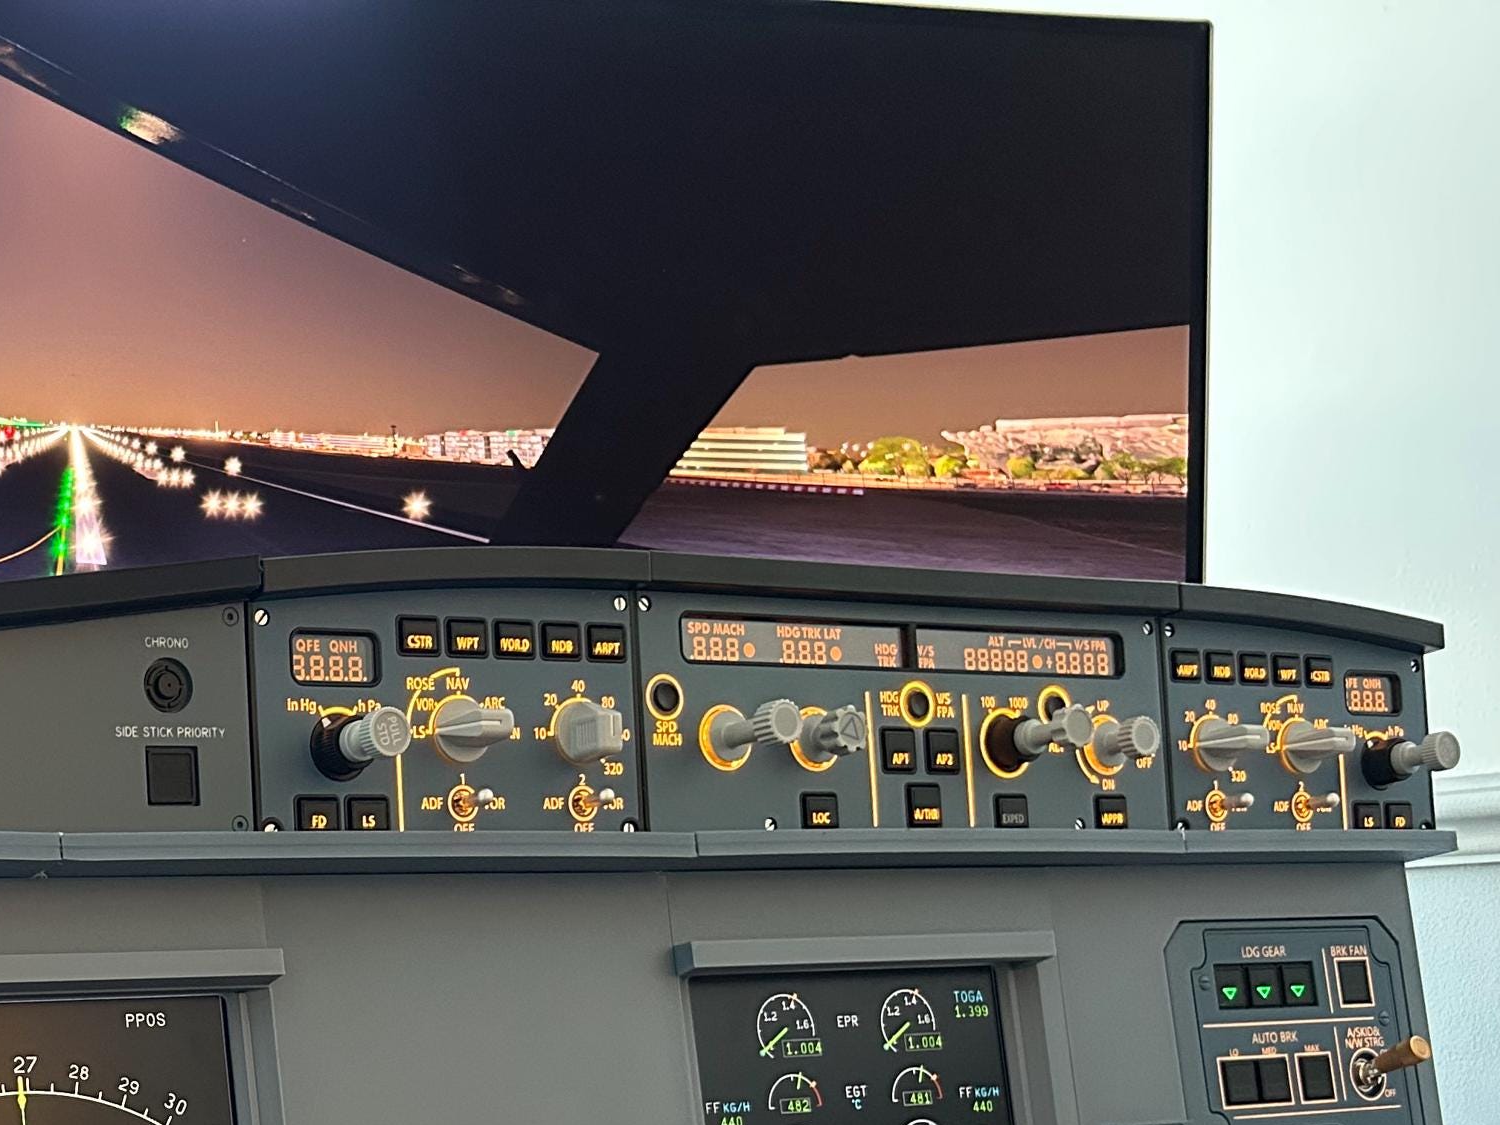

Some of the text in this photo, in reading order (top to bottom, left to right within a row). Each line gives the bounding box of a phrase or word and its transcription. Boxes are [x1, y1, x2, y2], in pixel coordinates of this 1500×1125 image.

[687, 622, 745, 635] SPD MACH
[777, 626, 841, 640] HDG TRK LAT
[145, 637, 189, 648] CHRONO
[296, 639, 357, 652] QFE QNH
[407, 635, 432, 648] CSTR
[457, 637, 479, 649] WPT
[552, 640, 573, 653] NDB
[407, 677, 435, 690] ROSE
[446, 677, 469, 690] NAV
[572, 680, 585, 693] 40
[485, 697, 505, 709] ARC
[544, 694, 557, 707] 20
[602, 696, 614, 709] 80
[880, 691, 899, 703] HDG
[981, 696, 995, 708] 100
[1288, 703, 1304, 715] NAV
[115, 727, 225, 738] SIDE STICK PRIORITY
[388, 716, 401, 745] PULL
[656, 721, 677, 732] SPD
[377, 723, 389, 745] STD
[653, 733, 682, 746] MACH
[604, 762, 623, 776] 320
[1232, 770, 1246, 782] 320
[421, 797, 443, 810] ADF
[543, 797, 564, 810] ADF
[1186, 801, 1202, 811] ADF
[1274, 801, 1289, 812] ADF
[311, 815, 327, 828] FD
[813, 812, 830, 824] LOC
[1002, 812, 1025, 824] EXPED
[1364, 817, 1374, 826] LS
[1396, 817, 1405, 826] FD
[1241, 946, 1286, 958] LDG GEAR
[1330, 945, 1367, 956] BRK FAN
[954, 990, 983, 1002] TOGA
[955, 1005, 988, 1018] 1.399
[126, 1013, 166, 1027] PPOS
[837, 1015, 859, 1028] EPR
[908, 1036, 942, 1049] 1.004
[1252, 1032, 1298, 1044] AUTO BRK
[1362, 1037, 1384, 1047] STRG
[787, 1042, 822, 1055] 1.004
[14, 1056, 37, 1074] 27
[69, 1064, 89, 1080] 28
[118, 1077, 140, 1095] 29
[846, 1085, 867, 1098] EGT
[959, 1086, 972, 1098] FF
[164, 1094, 187, 1116] 30
[706, 1102, 750, 1114] FF KG/H
[788, 1100, 809, 1112] 482
[973, 1100, 993, 1113] 440
